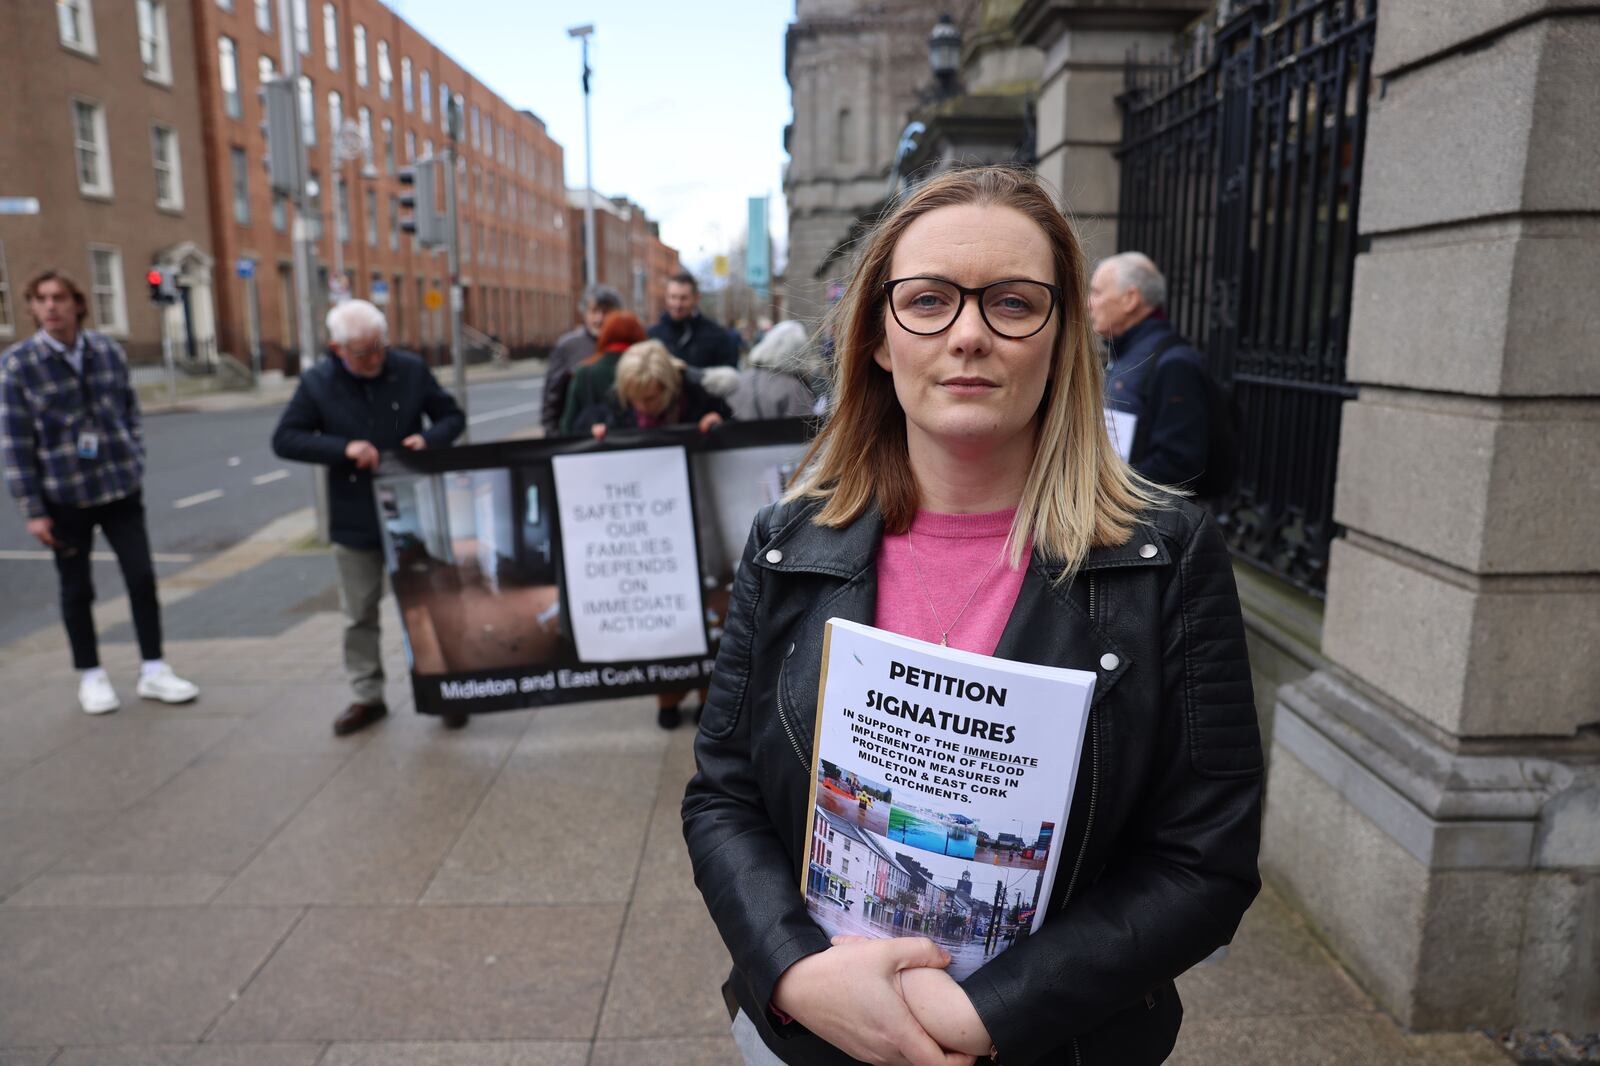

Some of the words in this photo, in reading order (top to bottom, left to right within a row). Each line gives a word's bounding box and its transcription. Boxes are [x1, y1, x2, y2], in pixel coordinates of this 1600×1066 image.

[605, 482, 640, 499] THE
[574, 501, 645, 521] SAFETY
[651, 499, 675, 517] OF
[606, 521, 647, 538] OUR
[585, 538, 672, 557] FAMILIES
[585, 558, 677, 578] DEPENDS
[618, 579, 648, 595] ON
[583, 594, 686, 614] IMMEDIATE
[440, 678, 517, 700] Midleton
[519, 670, 555, 693] and
[557, 668, 599, 688] East
[600, 666, 646, 686] Cork
[647, 661, 699, 682] Flood
[889, 660, 1007, 707] PETITION
[866, 689, 1016, 744] SIGNATURES
[843, 708, 855, 719] IN
[857, 714, 911, 738] SUPPORT
[914, 733, 931, 744] OF
[935, 738, 960, 752] THE
[964, 746, 1038, 767] IMMEDIATE
[851, 723, 955, 763] IMPLEMENTATION
[960, 758, 977, 767] OF
[980, 762, 1025, 776] FLOOD
[852, 736, 926, 768] PROTECTION
[929, 762, 1001, 785] MEASURES
[1004, 778, 1019, 788] IN
[858, 750, 917, 778] MIDLETON
[920, 772, 929, 781] &
[933, 776, 967, 790] EAST
[970, 784, 1008, 798] CORK
[884, 772, 972, 804] CATCHMENTS.
